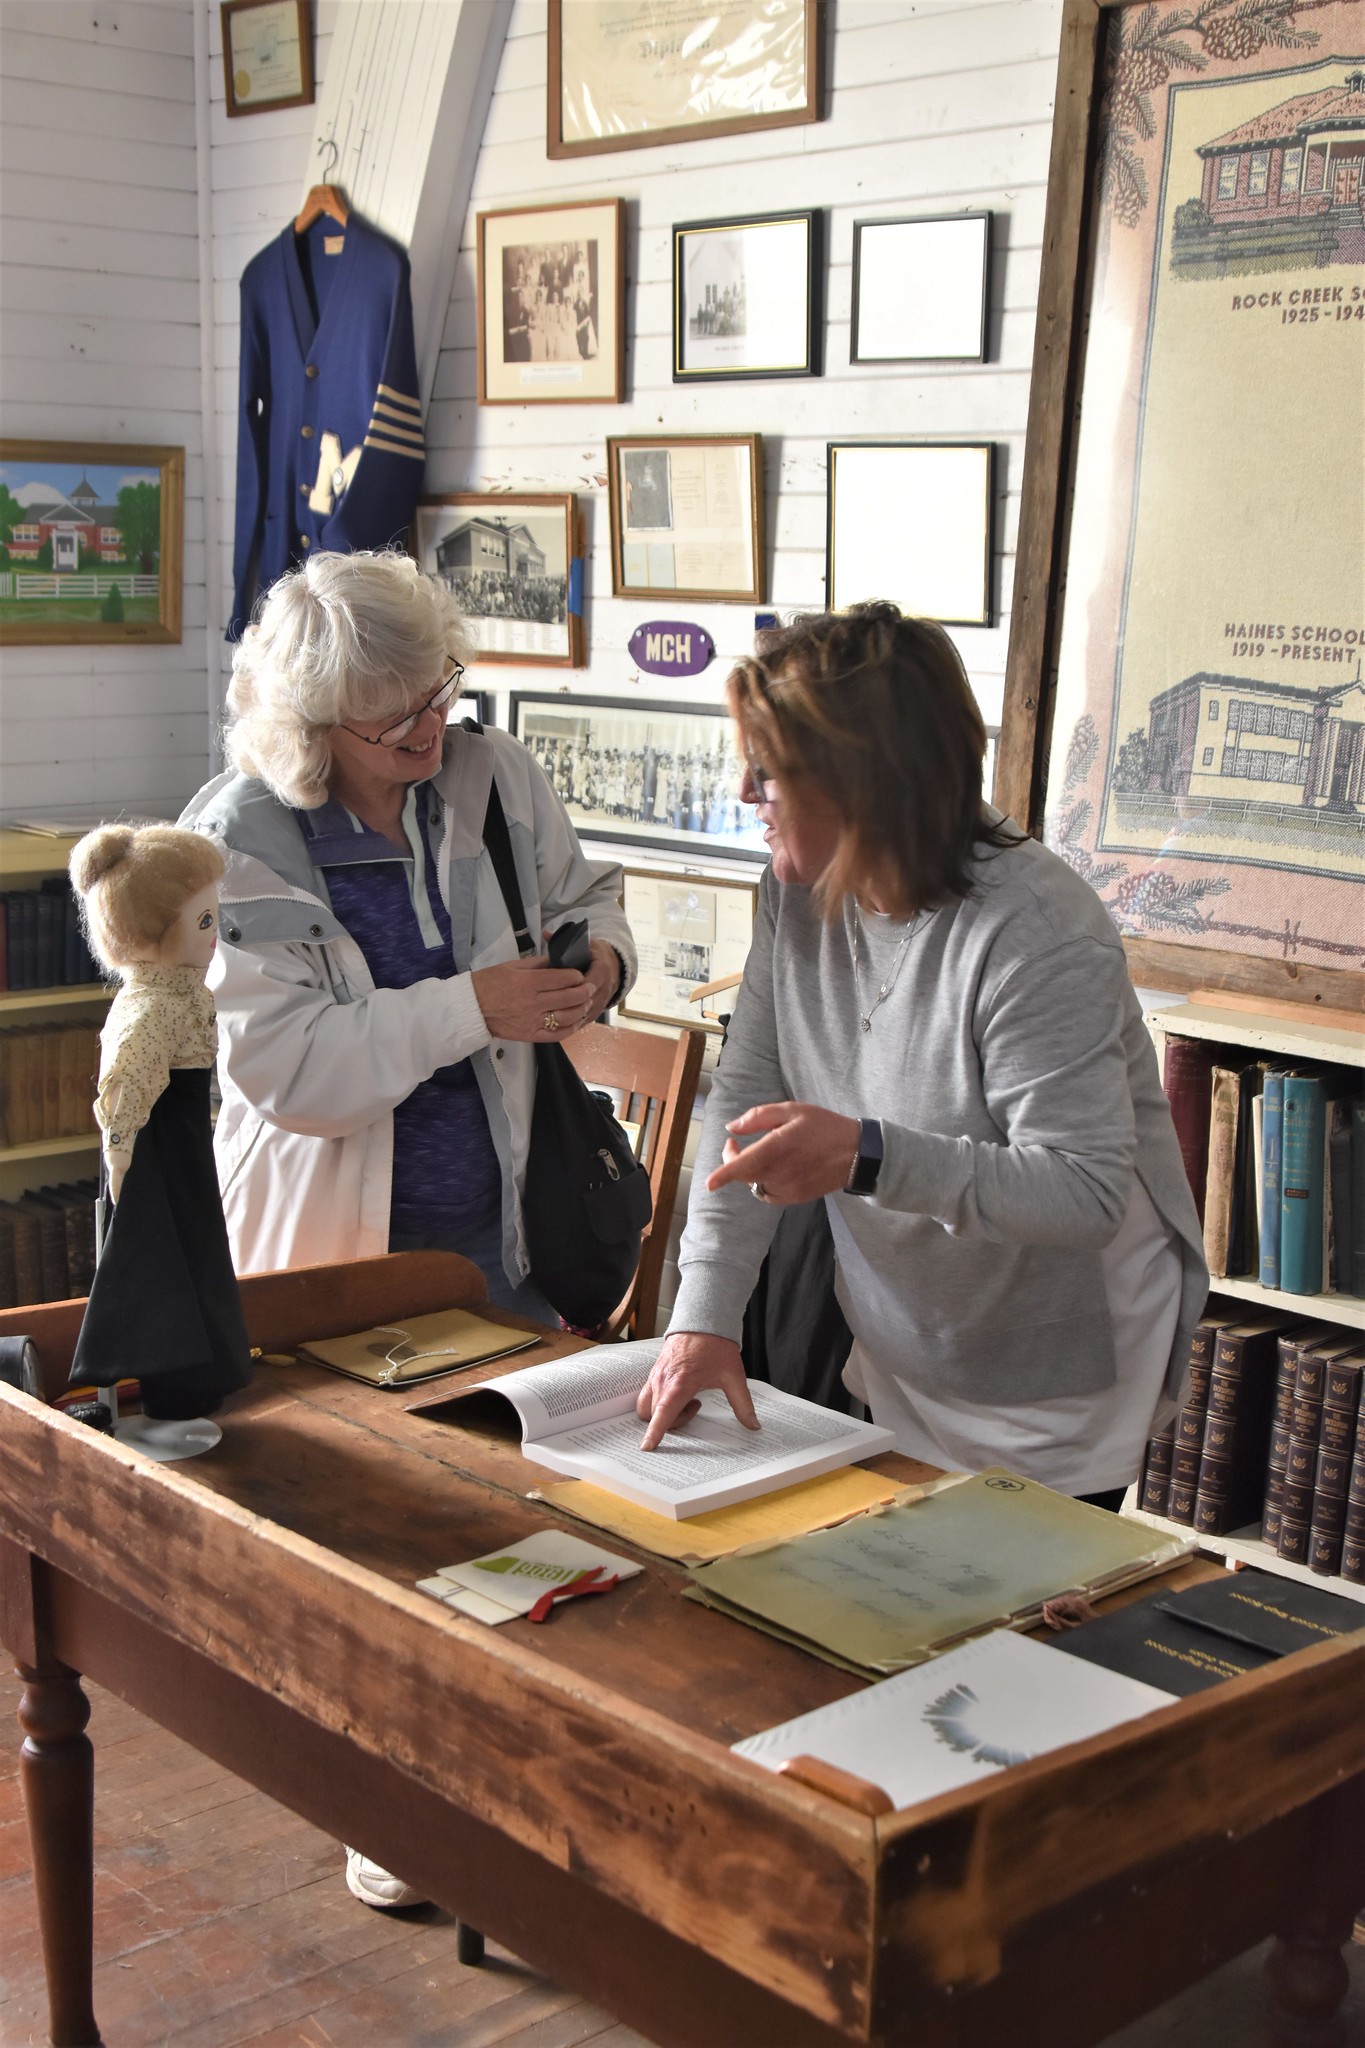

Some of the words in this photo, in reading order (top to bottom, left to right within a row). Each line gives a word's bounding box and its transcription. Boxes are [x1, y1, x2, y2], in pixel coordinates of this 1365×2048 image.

[1231, 291, 1283, 310] ROCK
[1288, 286, 1344, 305] CREEK
[1224, 623, 1286, 640] HAINES
[1291, 625, 1365, 645] SCHOOL
[645, 633, 691, 664] MCH
